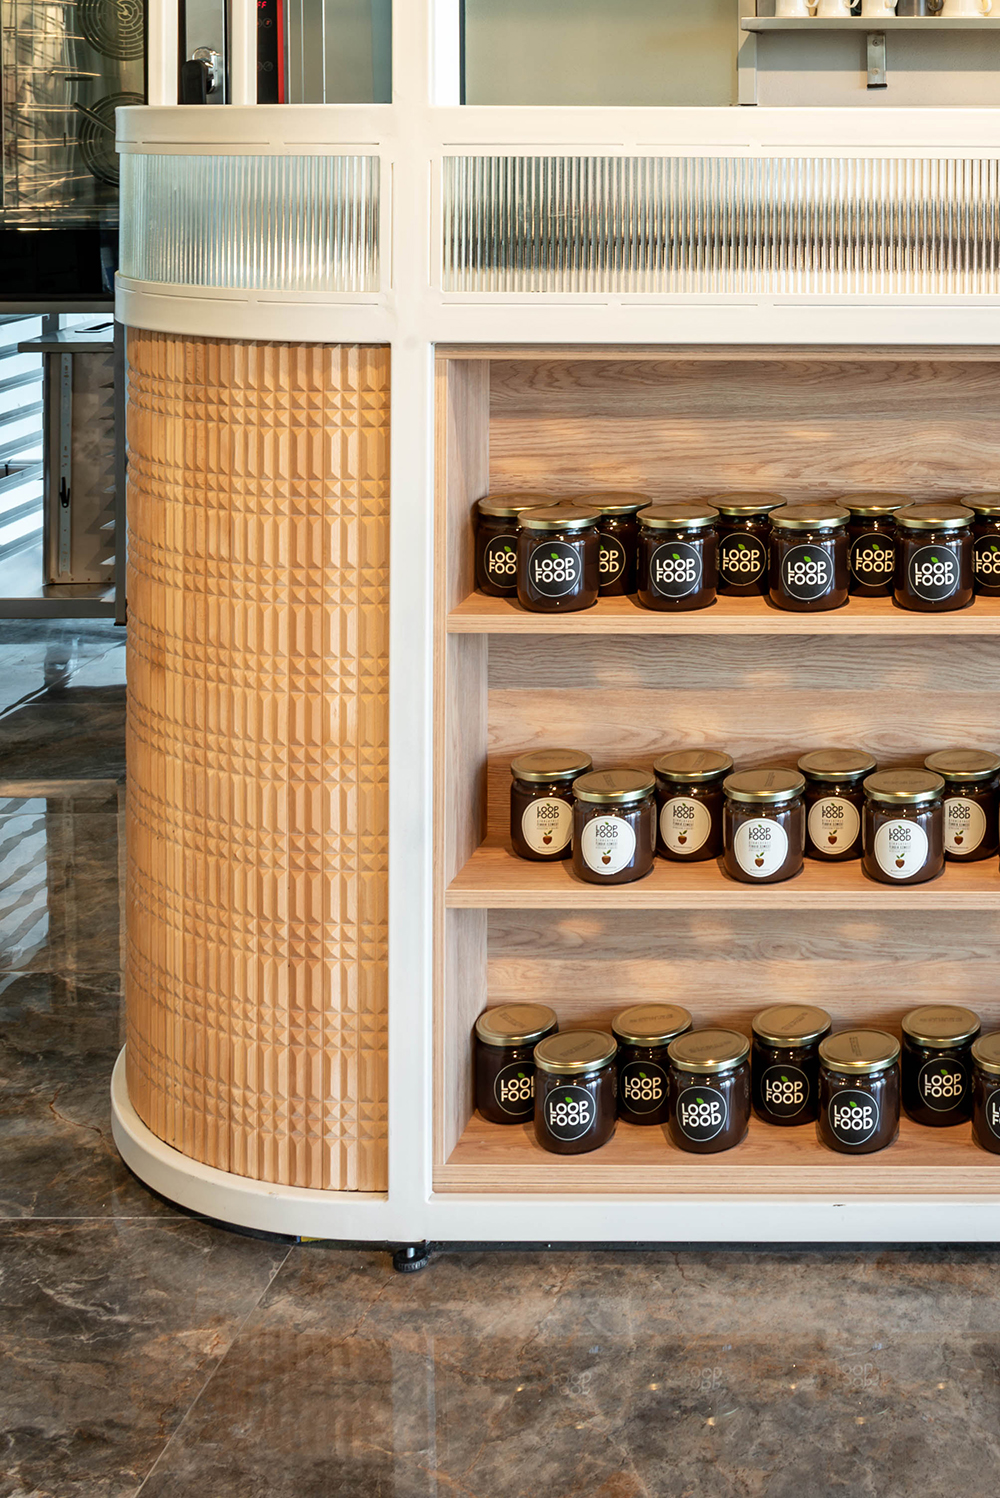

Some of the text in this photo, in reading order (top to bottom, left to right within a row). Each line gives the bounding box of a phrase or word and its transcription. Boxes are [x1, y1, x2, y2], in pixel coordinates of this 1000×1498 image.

[489, 551, 517, 562] LOO
[722, 548, 760, 561] LOOP
[855, 548, 893, 561] LOOP
[489, 562, 517, 574] FOO
[535, 557, 575, 571] LOOP
[656, 558, 696, 571] LOOP
[722, 560, 761, 572] FOOD
[788, 561, 826, 574] LOOP
[855, 560, 893, 573] FOOD
[915, 561, 953, 574] LOOP
[535, 569, 576, 583] FOOD
[656, 569, 696, 583] FOOD
[788, 572, 827, 585] FOOD
[915, 573, 954, 586] FOOD
[537, 805, 559, 813] LOOP
[673, 811, 694, 819] FOOD
[822, 811, 844, 819] FOOD
[749, 833, 771, 841] FOOD
[501, 1076, 534, 1091] LOO
[625, 1076, 661, 1089] LOOP
[925, 1073, 962, 1086] LOOP
[766, 1080, 802, 1093] LOOP
[925, 1084, 962, 1097] FOOD
[501, 1088, 534, 1102] FOO
[625, 1087, 662, 1101] FOOD
[766, 1091, 803, 1104] FOOD
[550, 1101, 589, 1115] LOOP
[682, 1102, 720, 1116] LOOP
[834, 1105, 872, 1118] LOOP
[550, 1112, 590, 1126] FOOD
[683, 1113, 721, 1127] FOOD
[834, 1116, 873, 1130] FOOD
